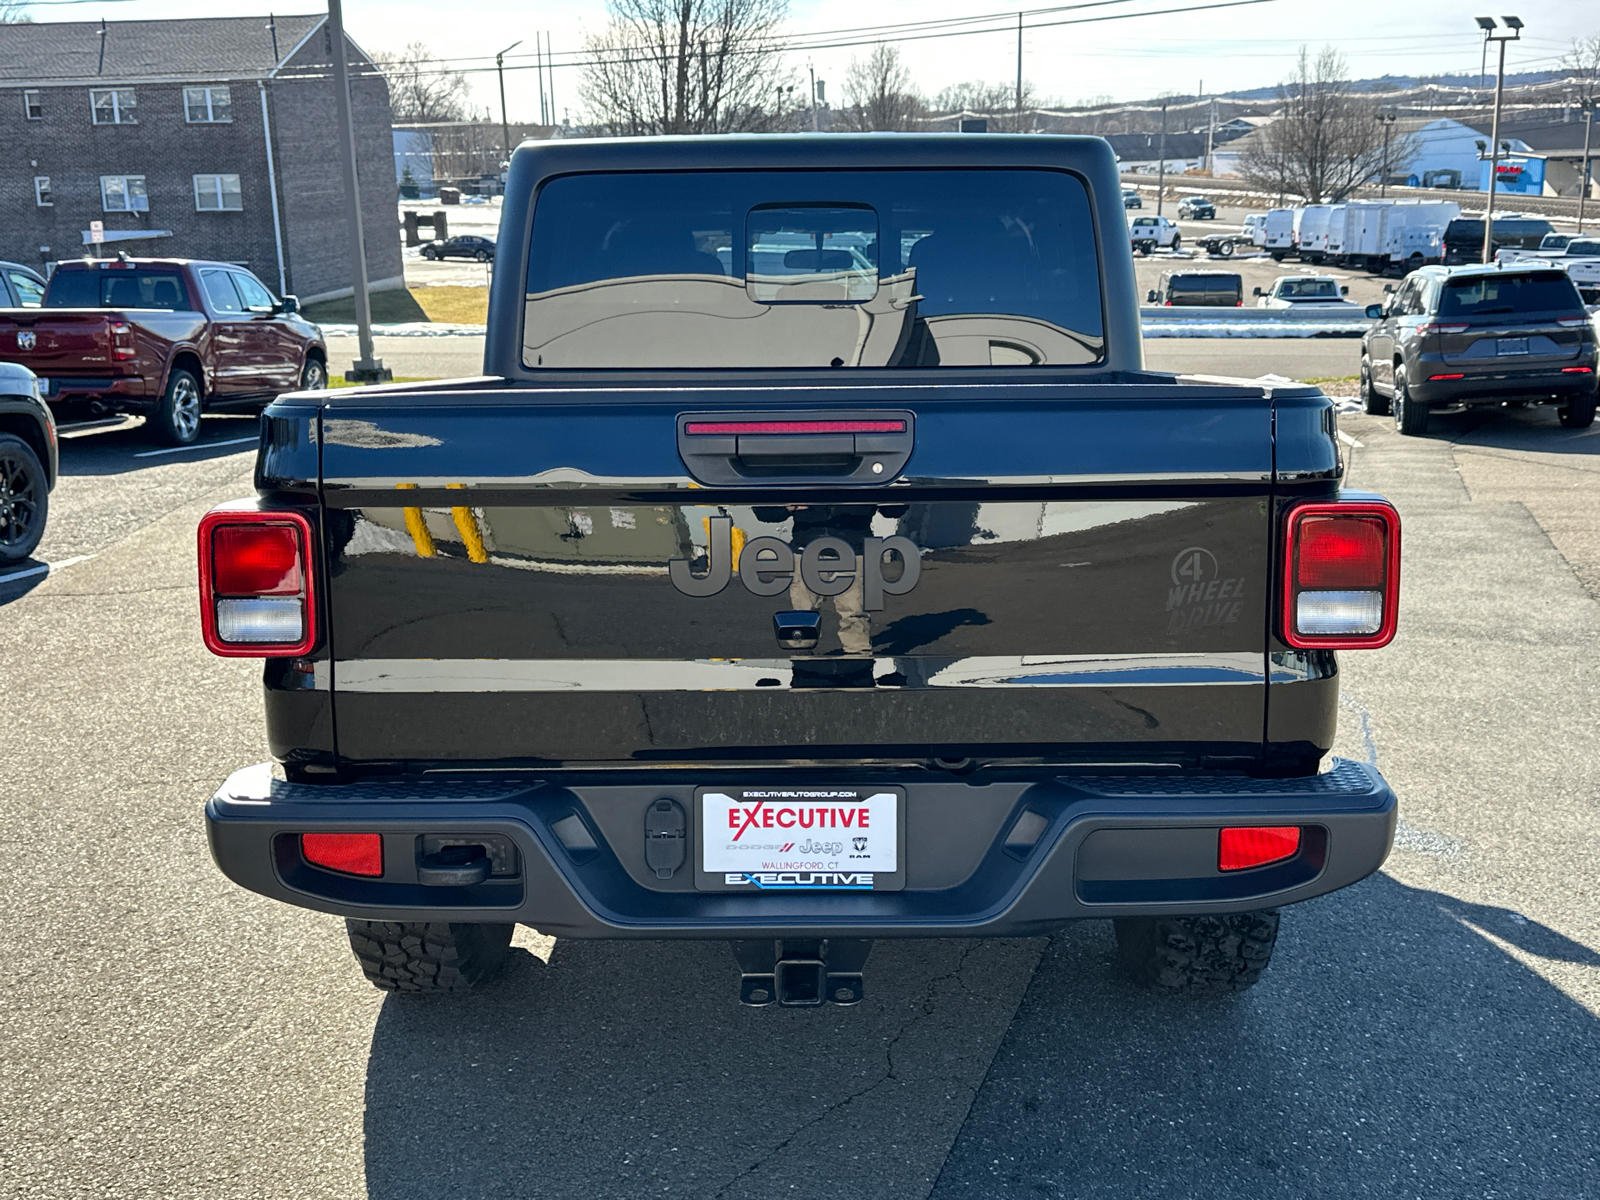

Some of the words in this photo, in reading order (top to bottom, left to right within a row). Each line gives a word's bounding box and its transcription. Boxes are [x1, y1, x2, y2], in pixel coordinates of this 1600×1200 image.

[668, 514, 922, 612] Jeep
[1179, 552, 1203, 581] 4
[1165, 577, 1245, 612] WHEEL
[728, 801, 870, 841] EXECUTIVE
[799, 839, 843, 856] Jeep
[761, 862, 826, 870] WALLINGFORD,
[828, 862, 839, 870] CT
[725, 873, 874, 889] EXECUTIVE
